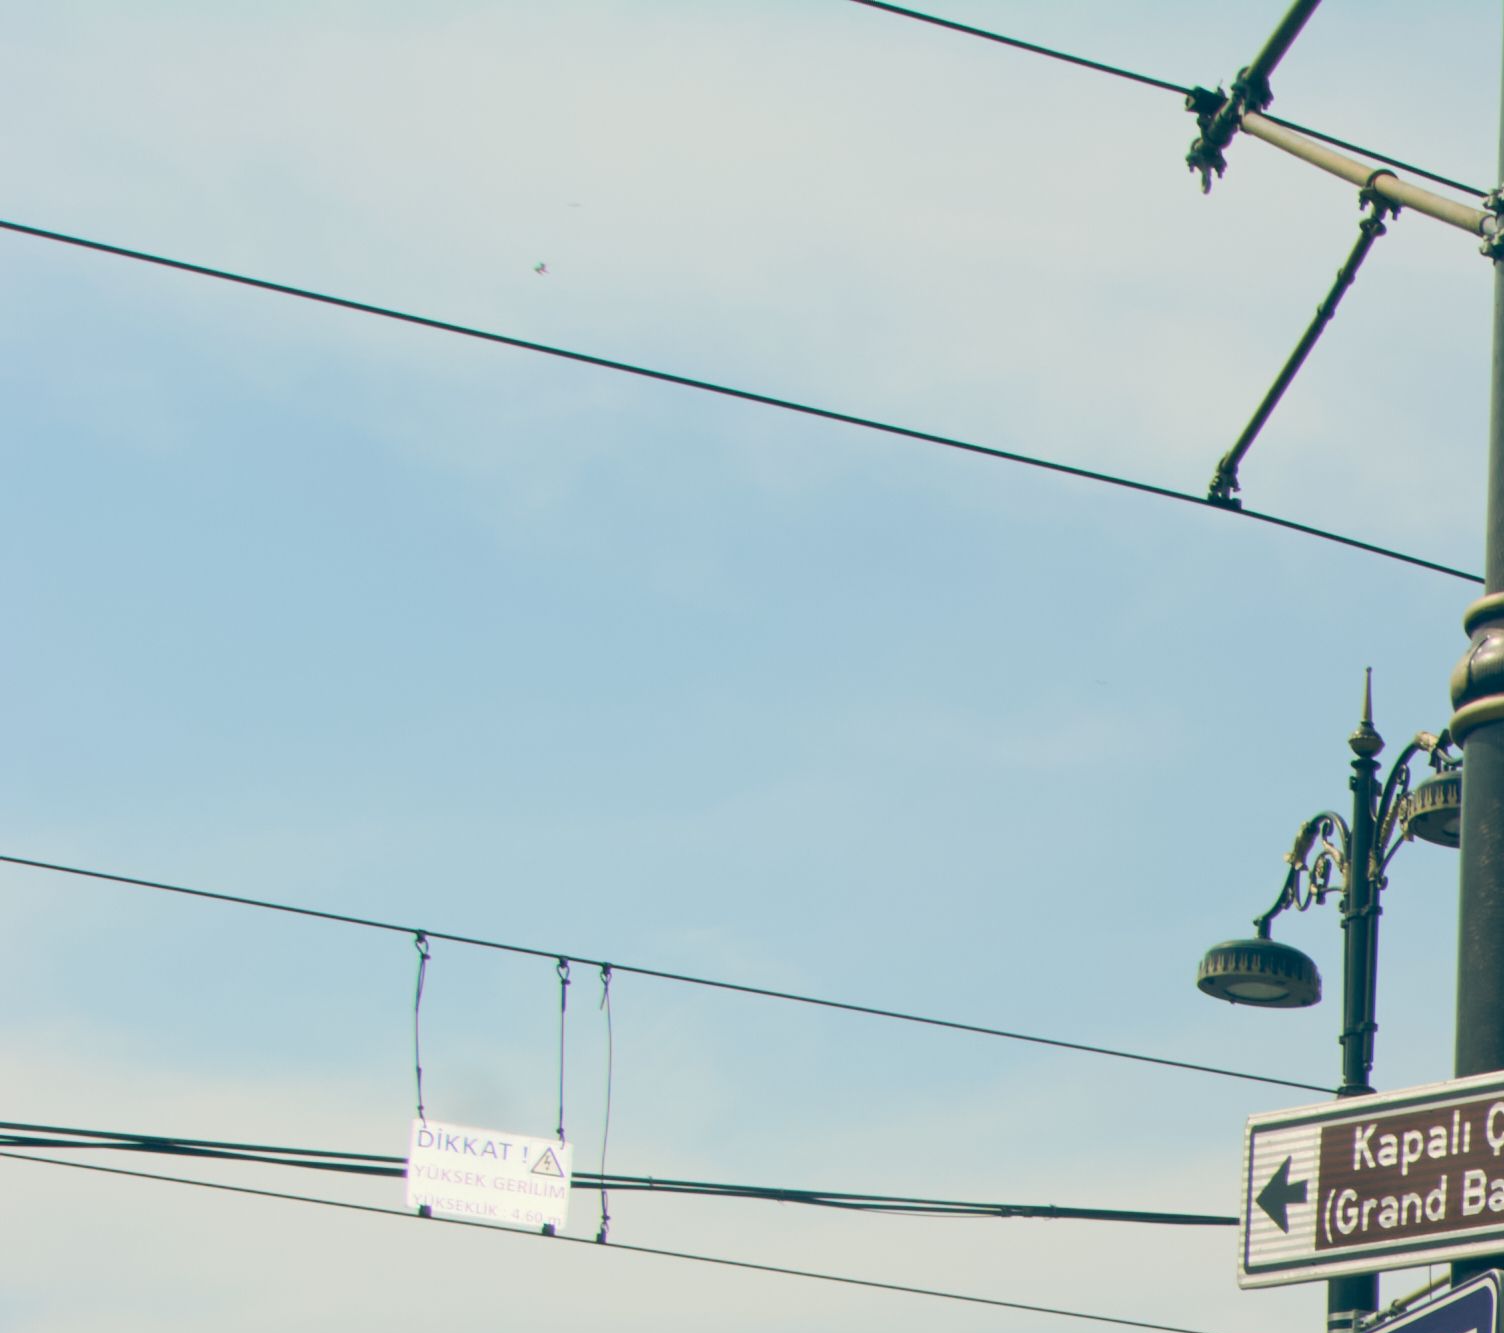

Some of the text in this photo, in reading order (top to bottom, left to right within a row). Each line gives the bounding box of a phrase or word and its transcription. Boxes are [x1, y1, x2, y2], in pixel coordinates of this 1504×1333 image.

[418, 1128, 512, 1160] DİKKAT
[1353, 1109, 1471, 1175] Kapalı
[414, 1164, 486, 1188] YÜKSEK
[1324, 1174, 1447, 1244] (Grand
